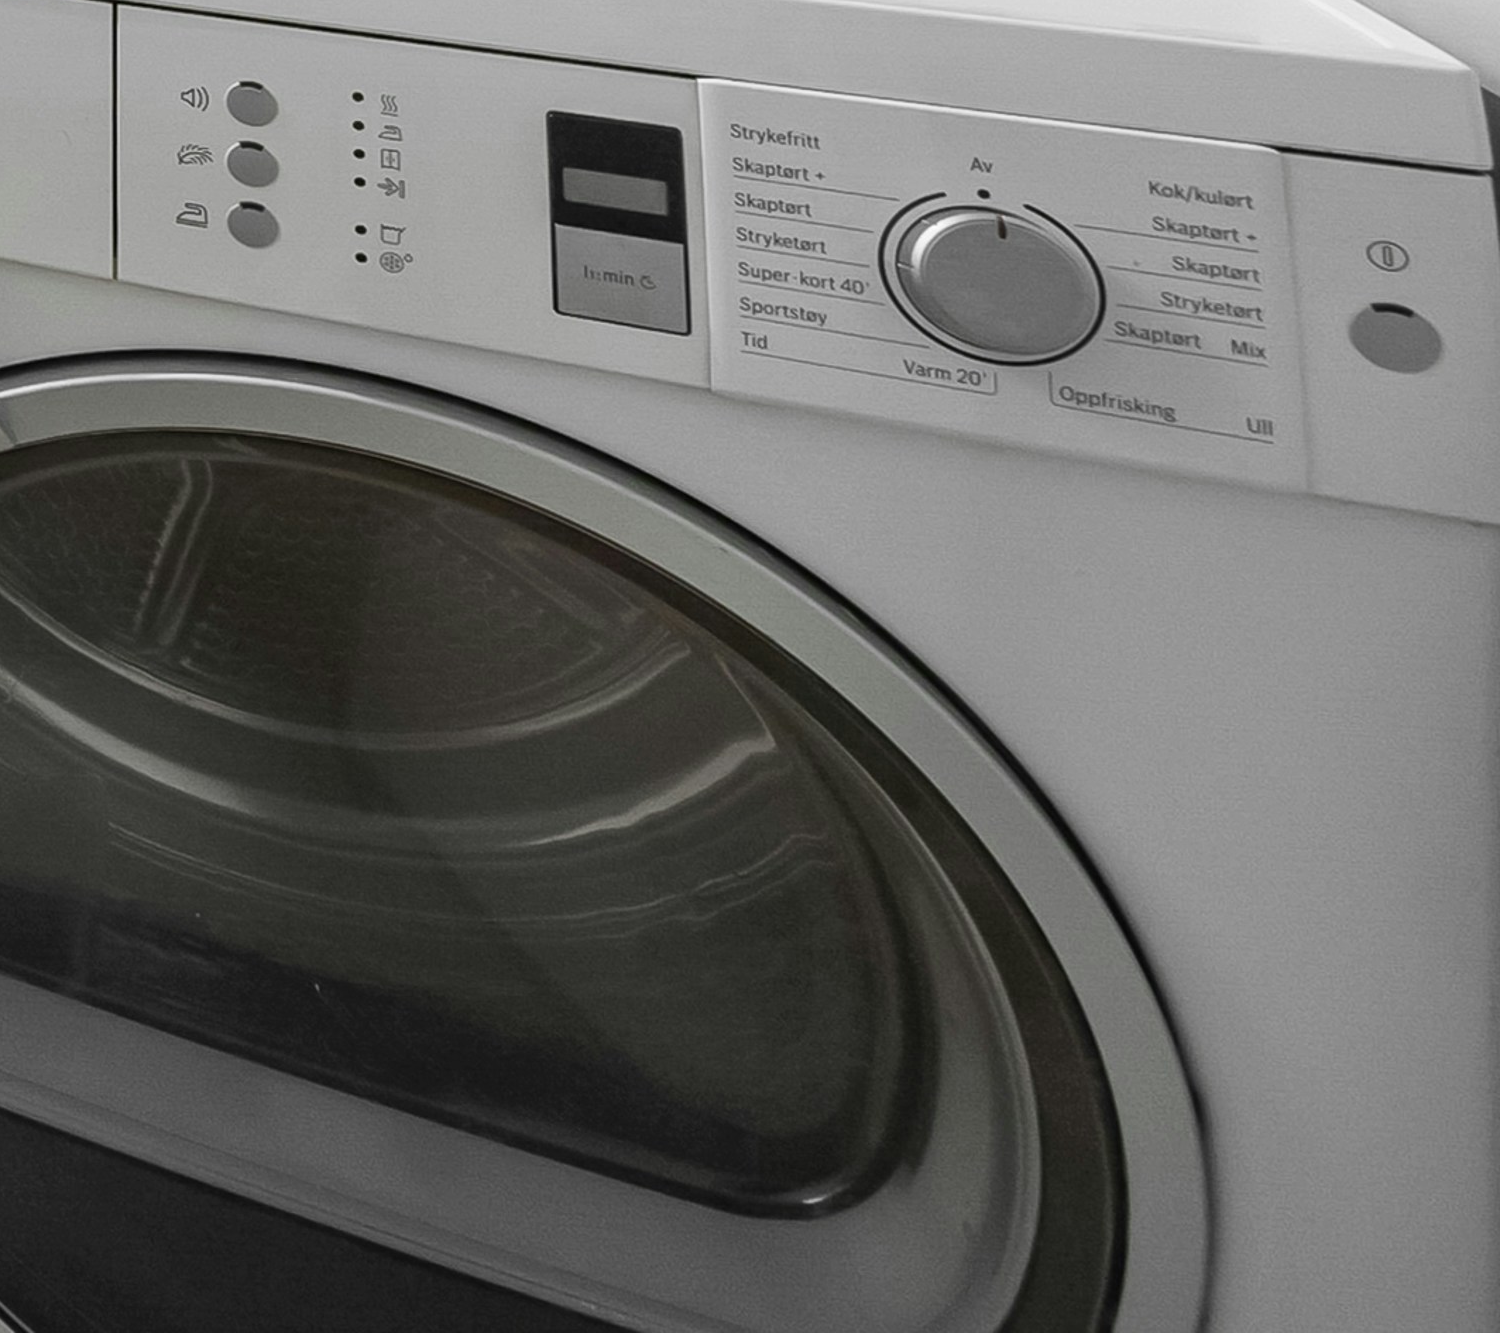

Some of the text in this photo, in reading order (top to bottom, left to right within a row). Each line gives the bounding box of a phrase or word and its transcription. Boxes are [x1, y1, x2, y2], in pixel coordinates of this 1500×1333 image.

[729, 123, 821, 151] Strykefritt
[732, 156, 811, 182] Skaptørt
[969, 156, 994, 174] Av
[734, 191, 812, 218] Skaptørt
[1148, 180, 1254, 210] Kok/kulørt
[735, 226, 828, 254] Stryketørt
[1152, 215, 1241, 243] Skaptørt
[737, 261, 836, 291] Super-kort
[1171, 255, 1261, 283] Skaptørt
[739, 296, 828, 326] Sportstøy
[1160, 290, 1264, 322] Stryketørt
[741, 331, 768, 350] Tid
[1114, 320, 1268, 360] Skaptørt Mix
[902, 358, 952, 381] Varm
[1058, 385, 1178, 423] Oppfrisking
[1246, 417, 1274, 436] Ull
